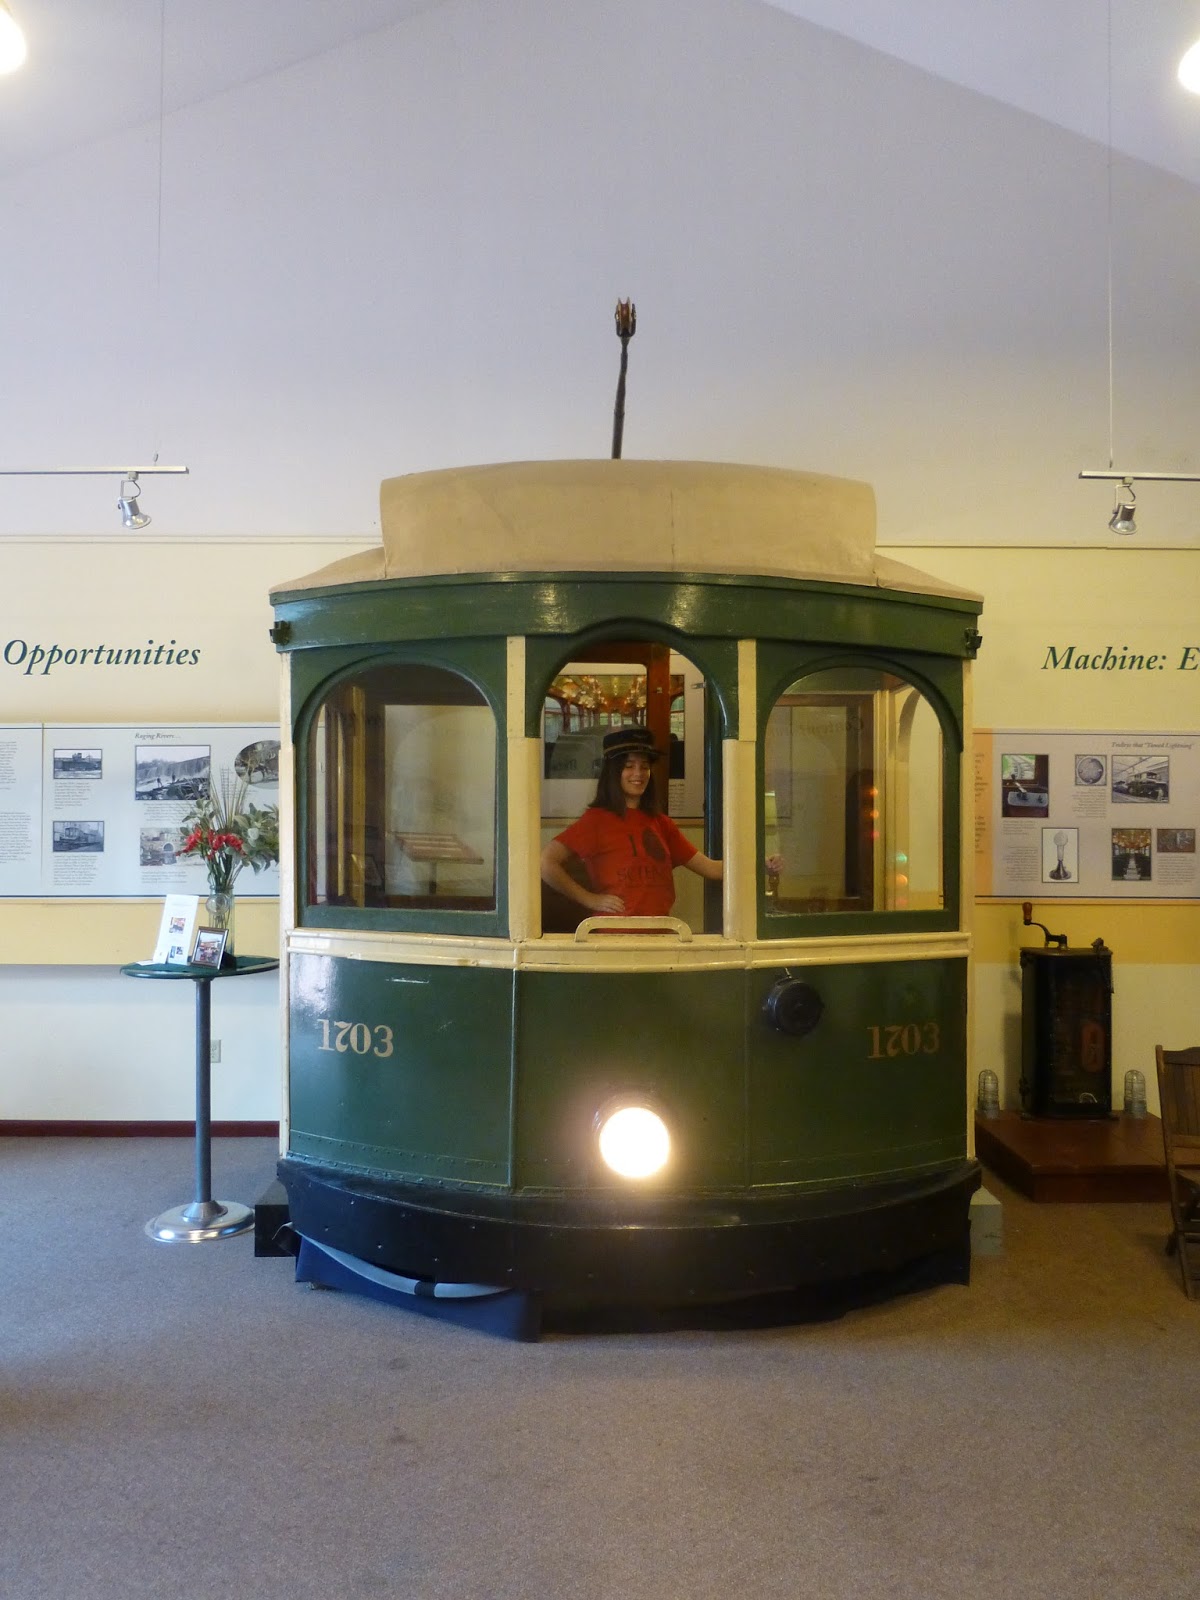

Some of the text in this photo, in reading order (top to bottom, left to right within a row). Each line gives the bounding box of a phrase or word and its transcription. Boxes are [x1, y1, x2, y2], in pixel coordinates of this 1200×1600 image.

[4, 639, 201, 676] Opportunities
[1041, 645, 1167, 671] Machine:
[316, 1018, 394, 1058] 1703
[866, 1022, 940, 1058] 1703
